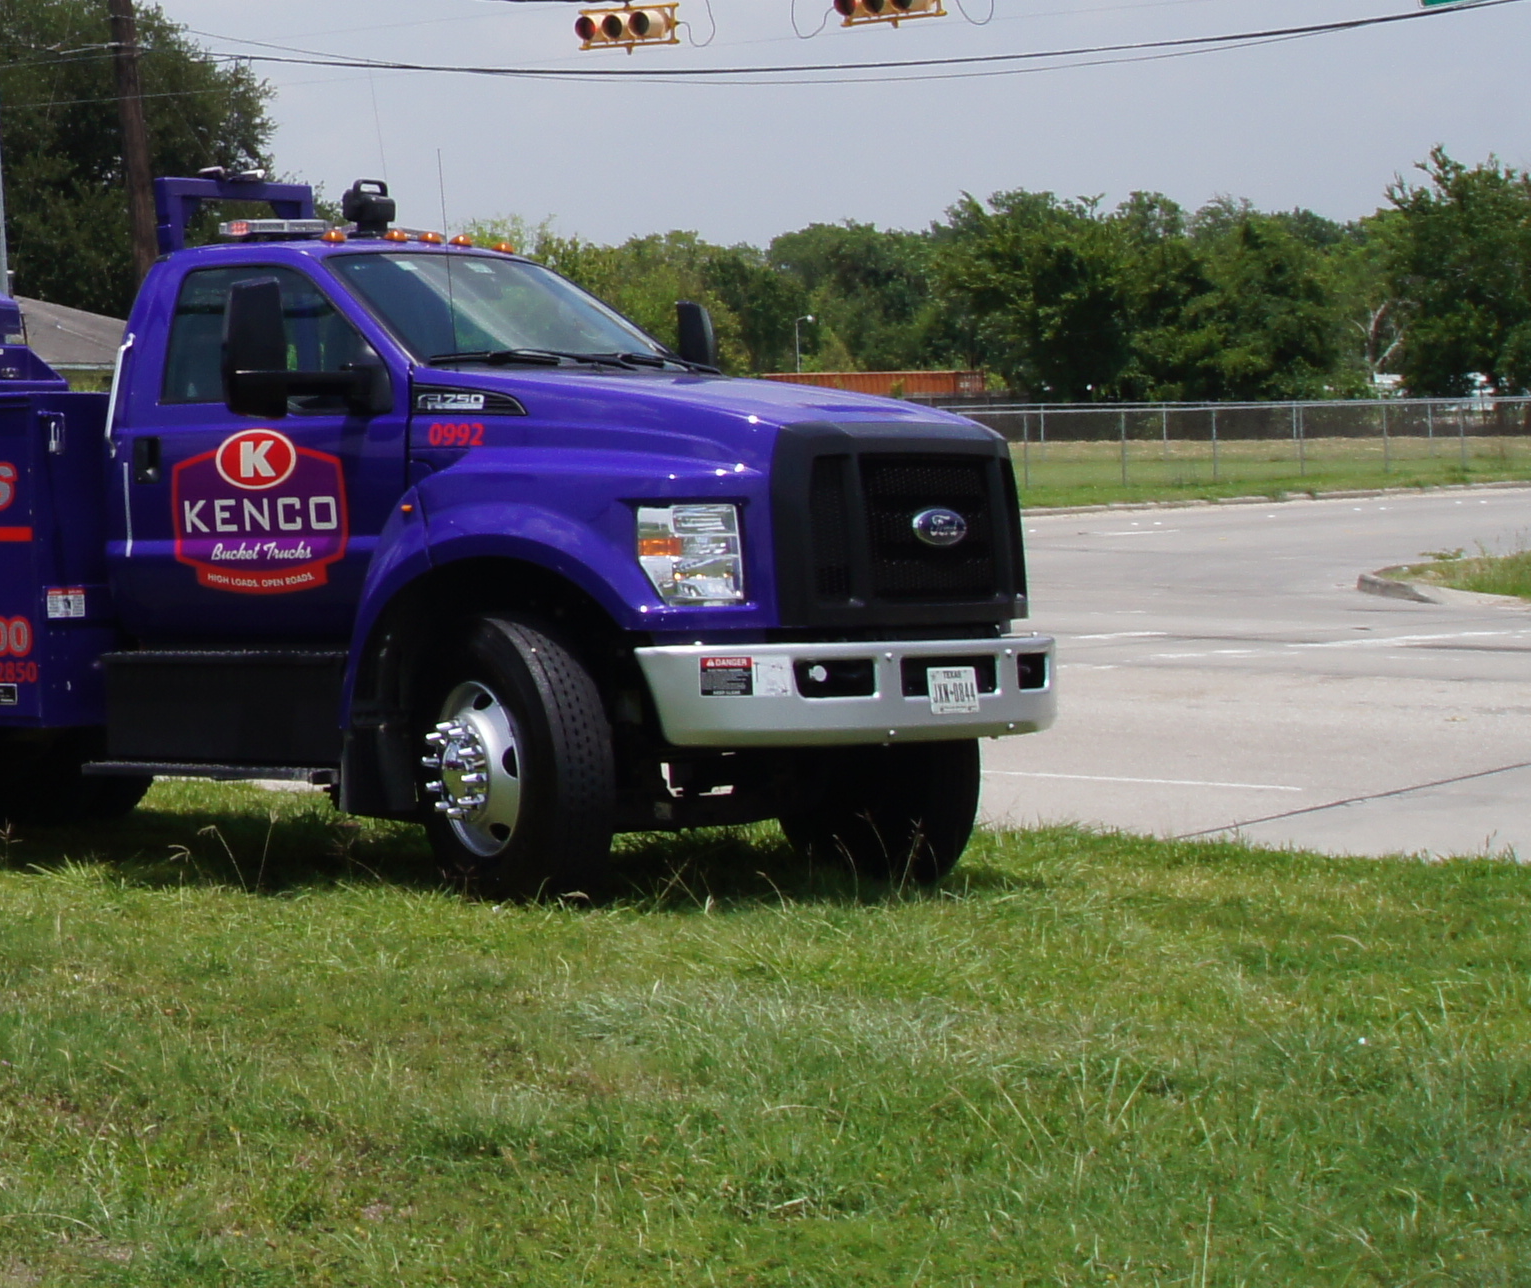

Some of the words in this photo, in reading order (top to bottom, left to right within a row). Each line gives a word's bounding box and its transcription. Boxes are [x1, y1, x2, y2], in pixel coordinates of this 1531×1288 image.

[428, 422, 484, 446] 0992
[240, 440, 277, 478] K
[184, 496, 338, 533] KENCO
[211, 542, 261, 561] Bucket
[263, 540, 312, 560] Trucks
[207, 573, 229, 584] HIGH
[262, 578, 284, 588] OPEN
[715, 658, 747, 667] DANGER
[943, 670, 962, 679] TEXAS
